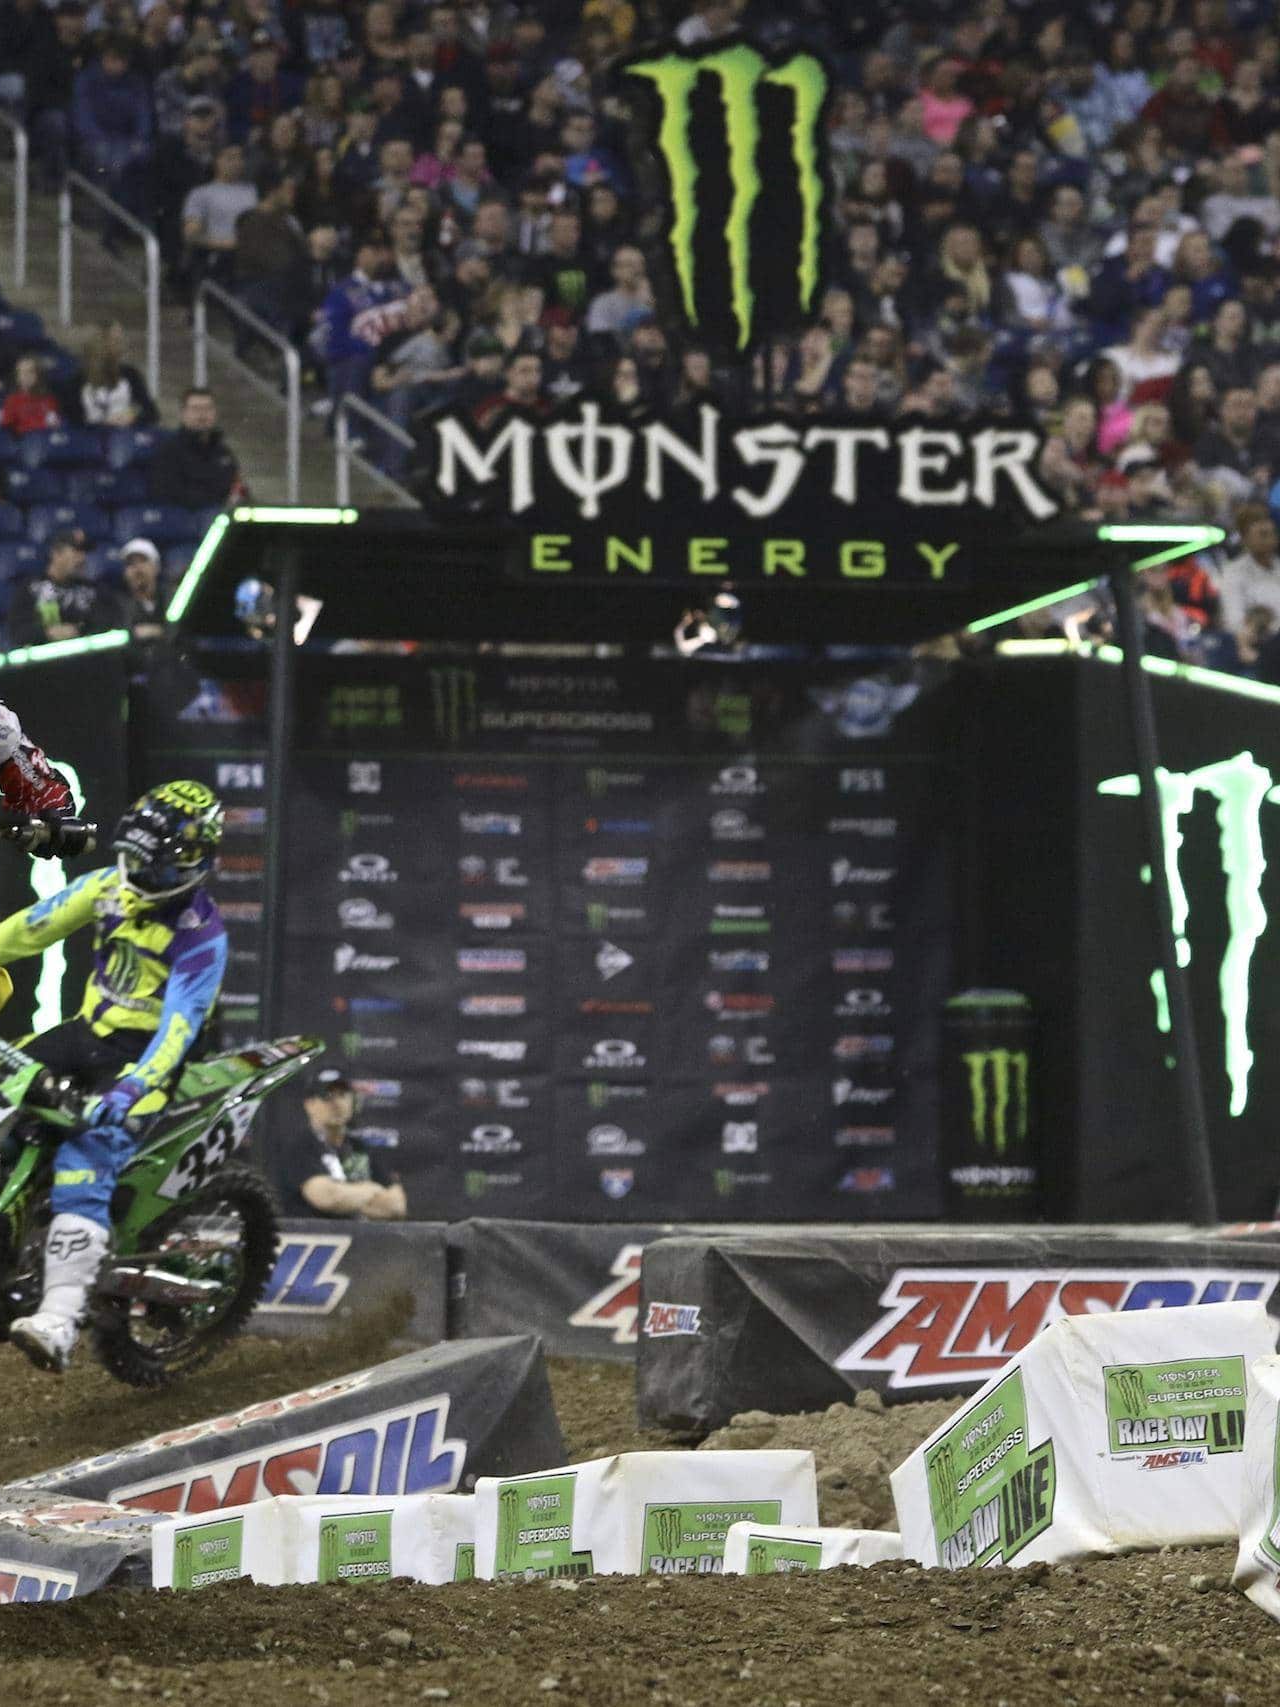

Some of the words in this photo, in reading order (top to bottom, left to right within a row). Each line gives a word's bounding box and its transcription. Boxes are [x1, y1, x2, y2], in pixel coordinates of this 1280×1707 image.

[436, 403, 1059, 518] MONSTER
[531, 534, 960, 579] ENERGY
[648, 1305, 699, 1334] AMSOIL
[863, 1280, 1266, 1377] AMS
[1158, 1368, 1221, 1382] MONSTER
[1148, 1386, 1242, 1404] SUPERCROSS
[1117, 1418, 1169, 1445] RACE
[1168, 1415, 1207, 1441] DAY
[1211, 1410, 1245, 1447] LI
[117, 1408, 443, 1512] MSOIL
[957, 1427, 1024, 1495] SUPERCROSS
[1143, 1451, 1206, 1470] AMSOIL
[972, 1495, 1001, 1556] DAY
[1002, 1454, 1049, 1549] LIVE
[518, 1525, 570, 1545] SUPERCROSS
[682, 1531, 727, 1543] SUPER
[337, 1561, 391, 1579] SUPERCROSS
[650, 1555, 696, 1574] RACE
[699, 1554, 725, 1574] DA
[191, 1567, 240, 1588] SUPERCROSS
